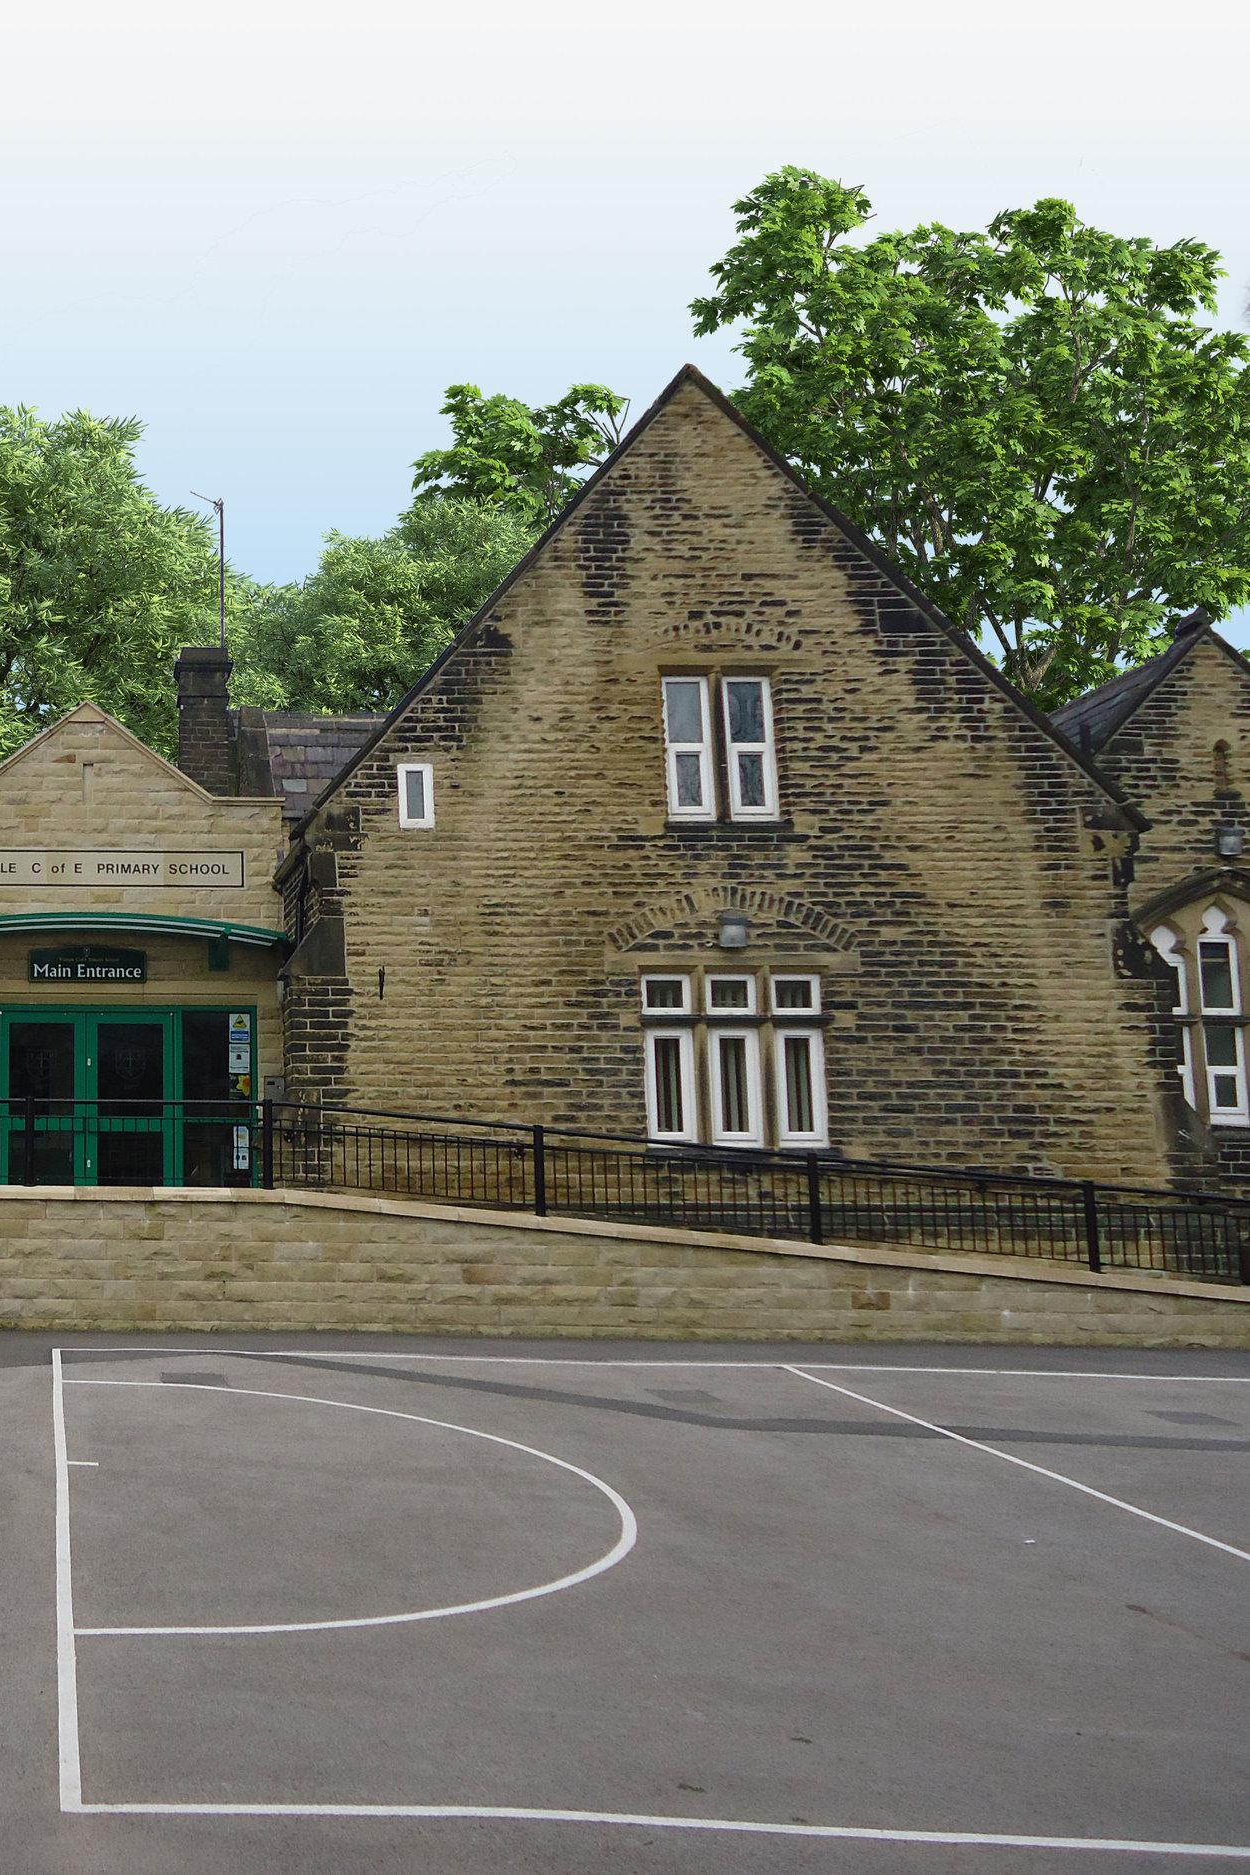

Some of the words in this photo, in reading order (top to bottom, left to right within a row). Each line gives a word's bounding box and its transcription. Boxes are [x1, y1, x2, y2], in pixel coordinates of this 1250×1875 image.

[31, 862, 41, 873] C
[51, 863, 66, 873] of
[74, 863, 83, 873] E
[97, 863, 160, 874] PRIMARY
[168, 863, 230, 875] SCHOOL
[33, 963, 71, 978] Main
[77, 963, 142, 978] Entrance
